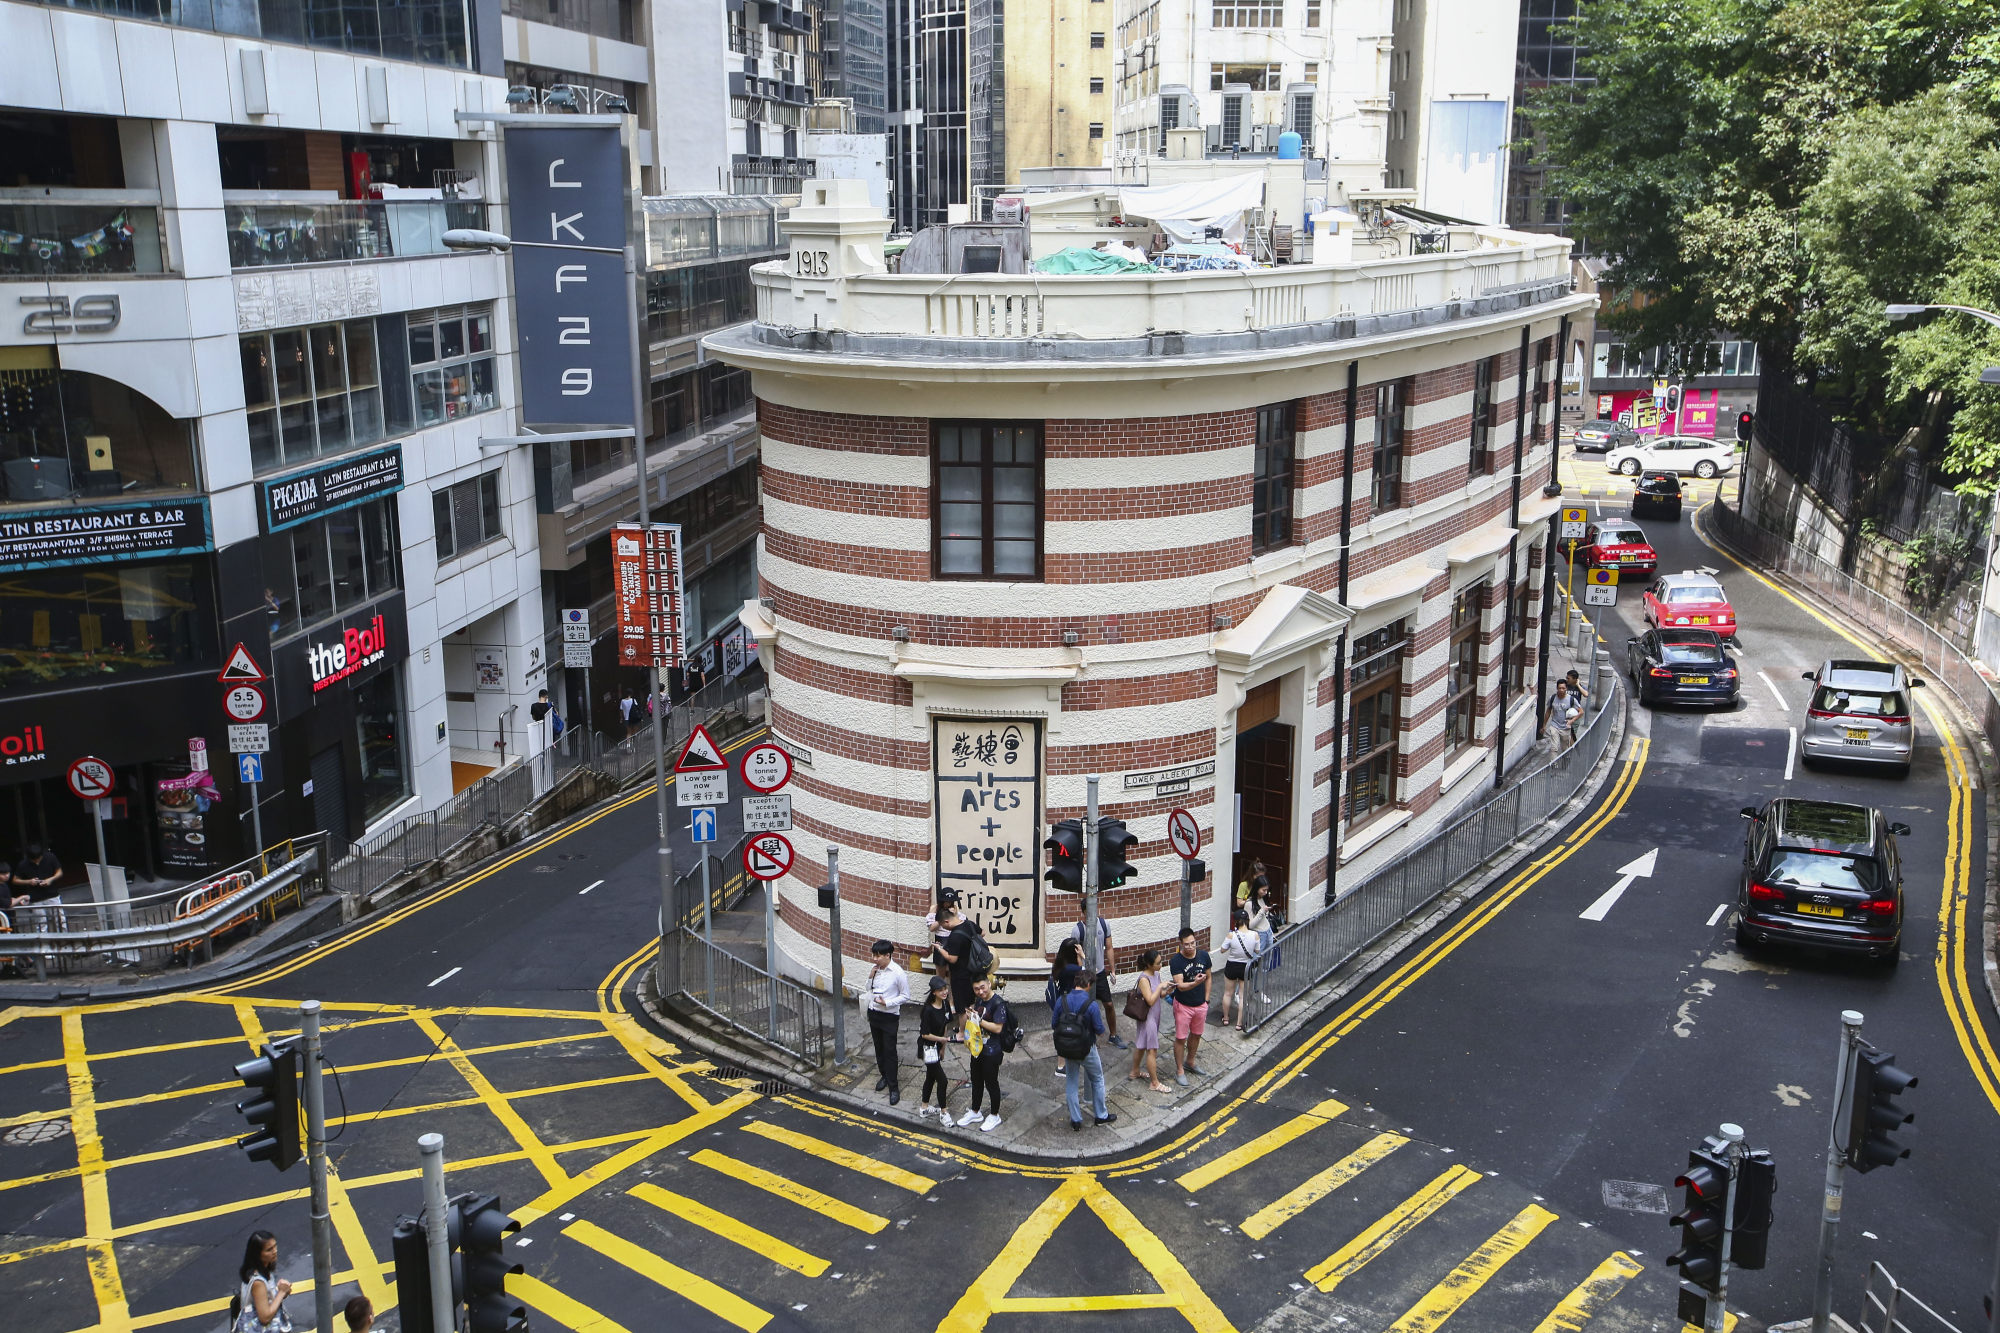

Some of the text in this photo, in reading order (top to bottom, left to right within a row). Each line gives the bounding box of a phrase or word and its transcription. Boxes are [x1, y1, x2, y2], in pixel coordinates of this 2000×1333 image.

[797, 250, 829, 275] 1913
[323, 456, 397, 487] LATIN RESTAURANT & BAR
[272, 478, 318, 510] PICADA
[34, 513, 134, 534] RESTAURANT
[139, 512, 151, 524] &
[155, 509, 185, 523] BAR
[13, 538, 85, 552] RESTAURANT/BAR
[89, 535, 102, 545] 3/F
[104, 533, 131, 543] SHISHA
[138, 529, 173, 540] TERRACE
[31, 550, 50, 558] DAYS
[110, 541, 135, 550] LUNCH
[620, 562, 628, 595] HERITAGE
[623, 604, 631, 621] ARTS
[235, 661, 249, 671] 1:8
[313, 650, 385, 693] RESTAURANT & BAR
[233, 691, 254, 702] 5.5
[0, 725, 45, 755] oil
[951, 725, 1024, 768] 藝穗會
[19, 753, 46, 763] BAR
[697, 748, 708, 757] 1:8
[756, 753, 777, 765] 5.5
[1126, 763, 1214, 784] LOWER ALBERT ROAD
[681, 791, 725, 801] 低波行車
[960, 788, 1021, 813] Arts
[753, 850, 777, 871] L
